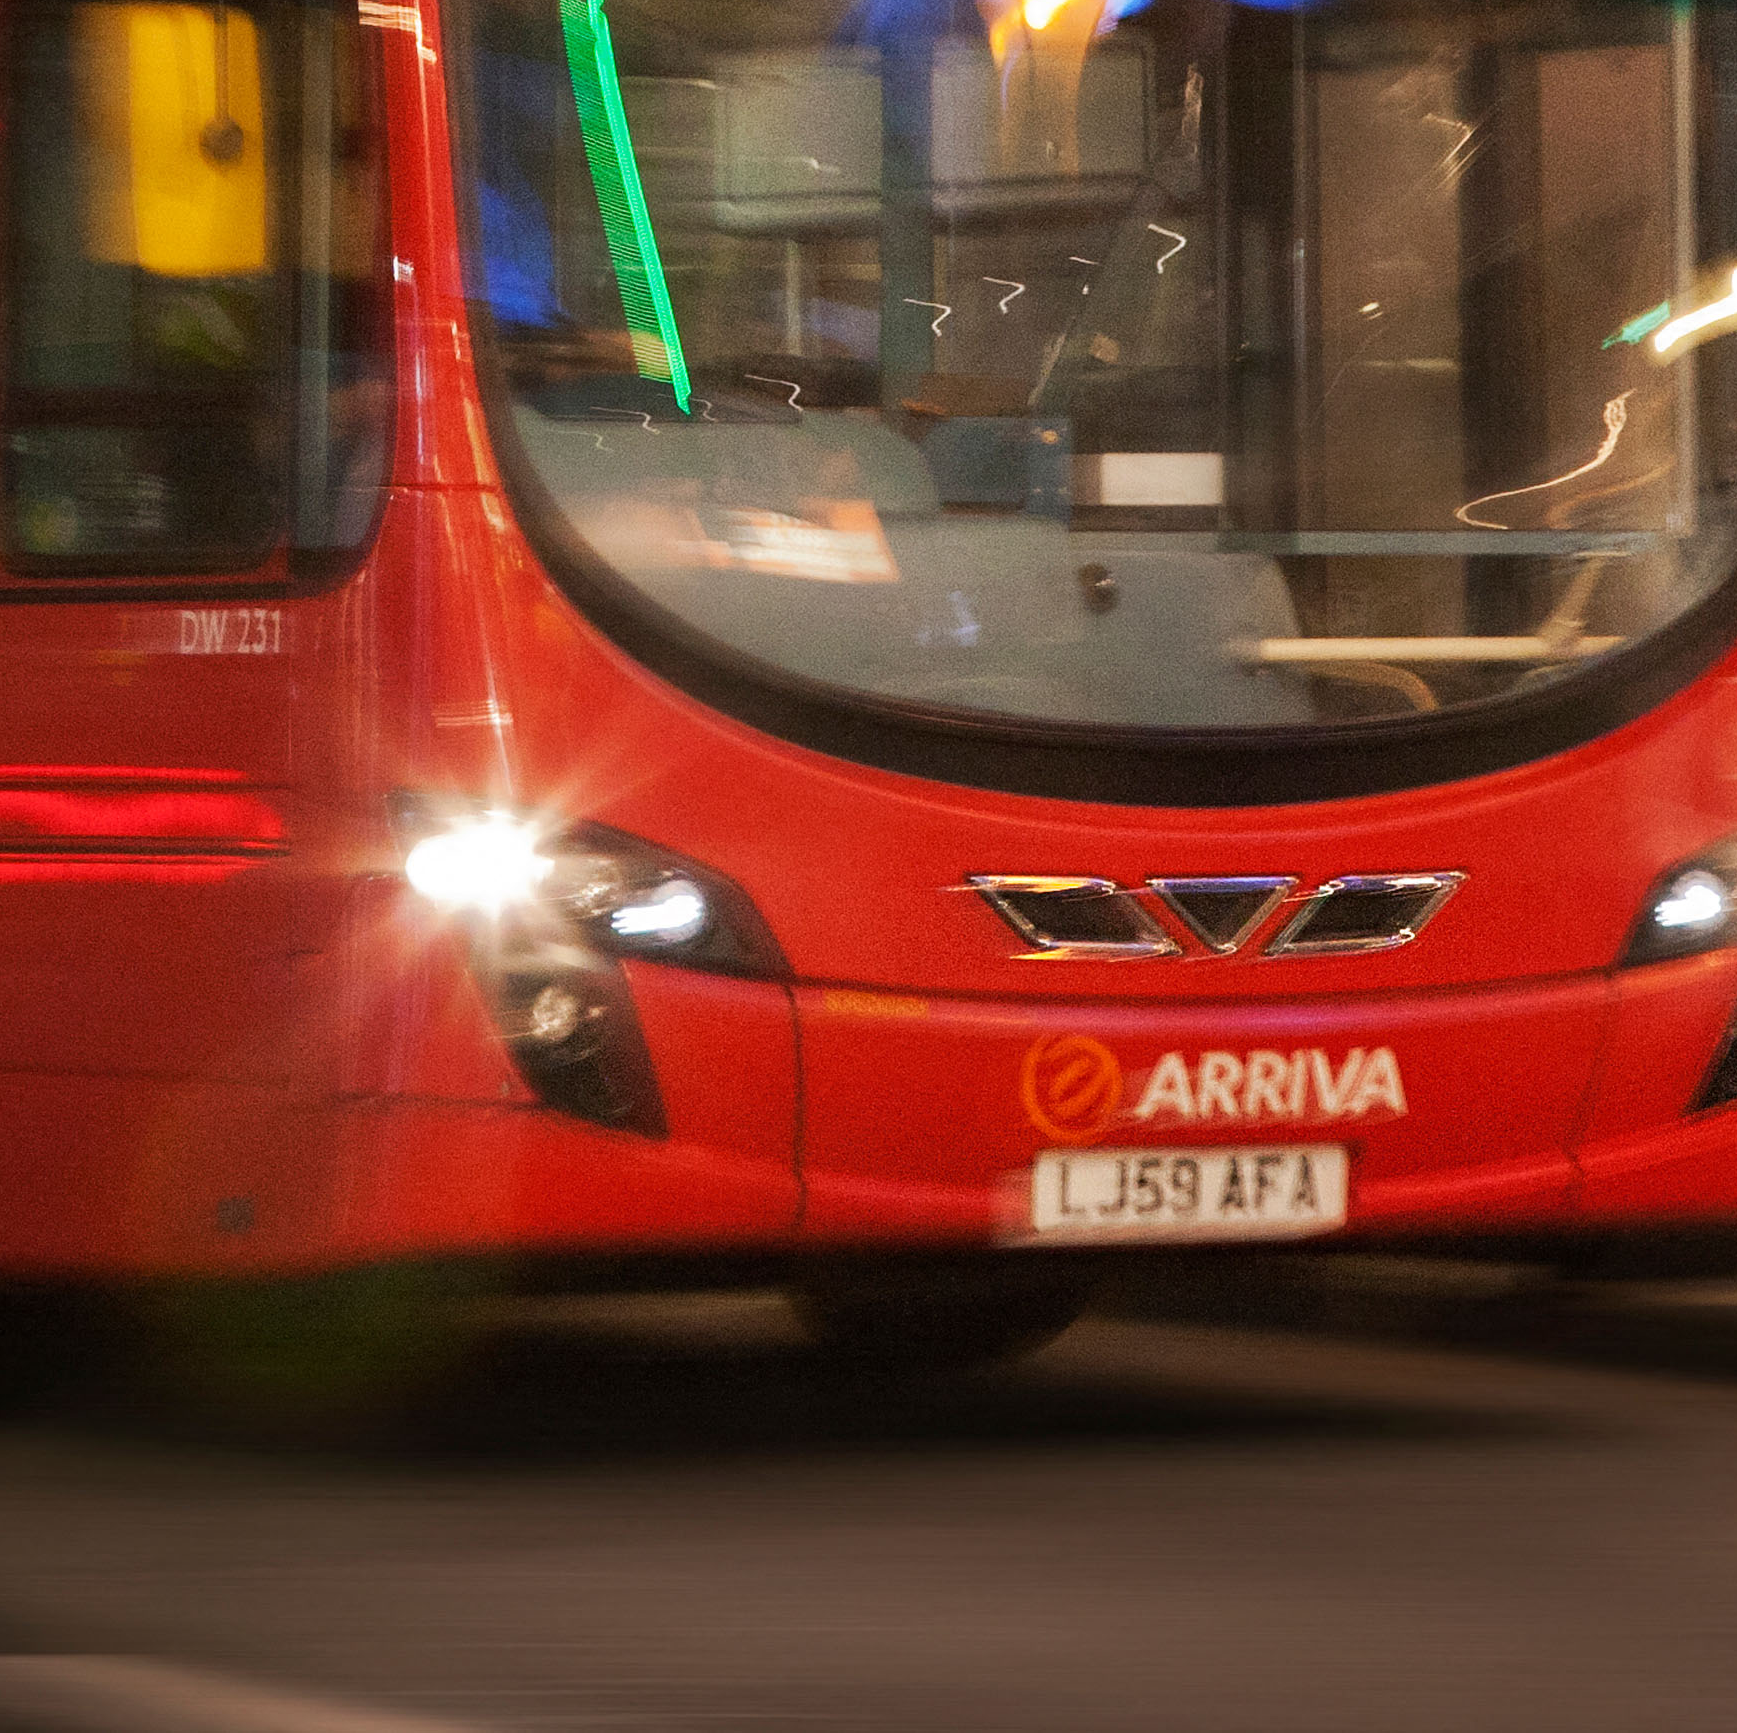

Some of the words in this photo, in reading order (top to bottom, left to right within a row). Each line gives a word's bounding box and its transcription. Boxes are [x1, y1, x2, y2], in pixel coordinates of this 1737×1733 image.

[180, 608, 227, 655] DW
[236, 608, 281, 655] 231
[1132, 1045, 1410, 1122] ARRIVA
[1058, 1156, 1203, 1217] LJ59
[1218, 1152, 1320, 1213] AFA
